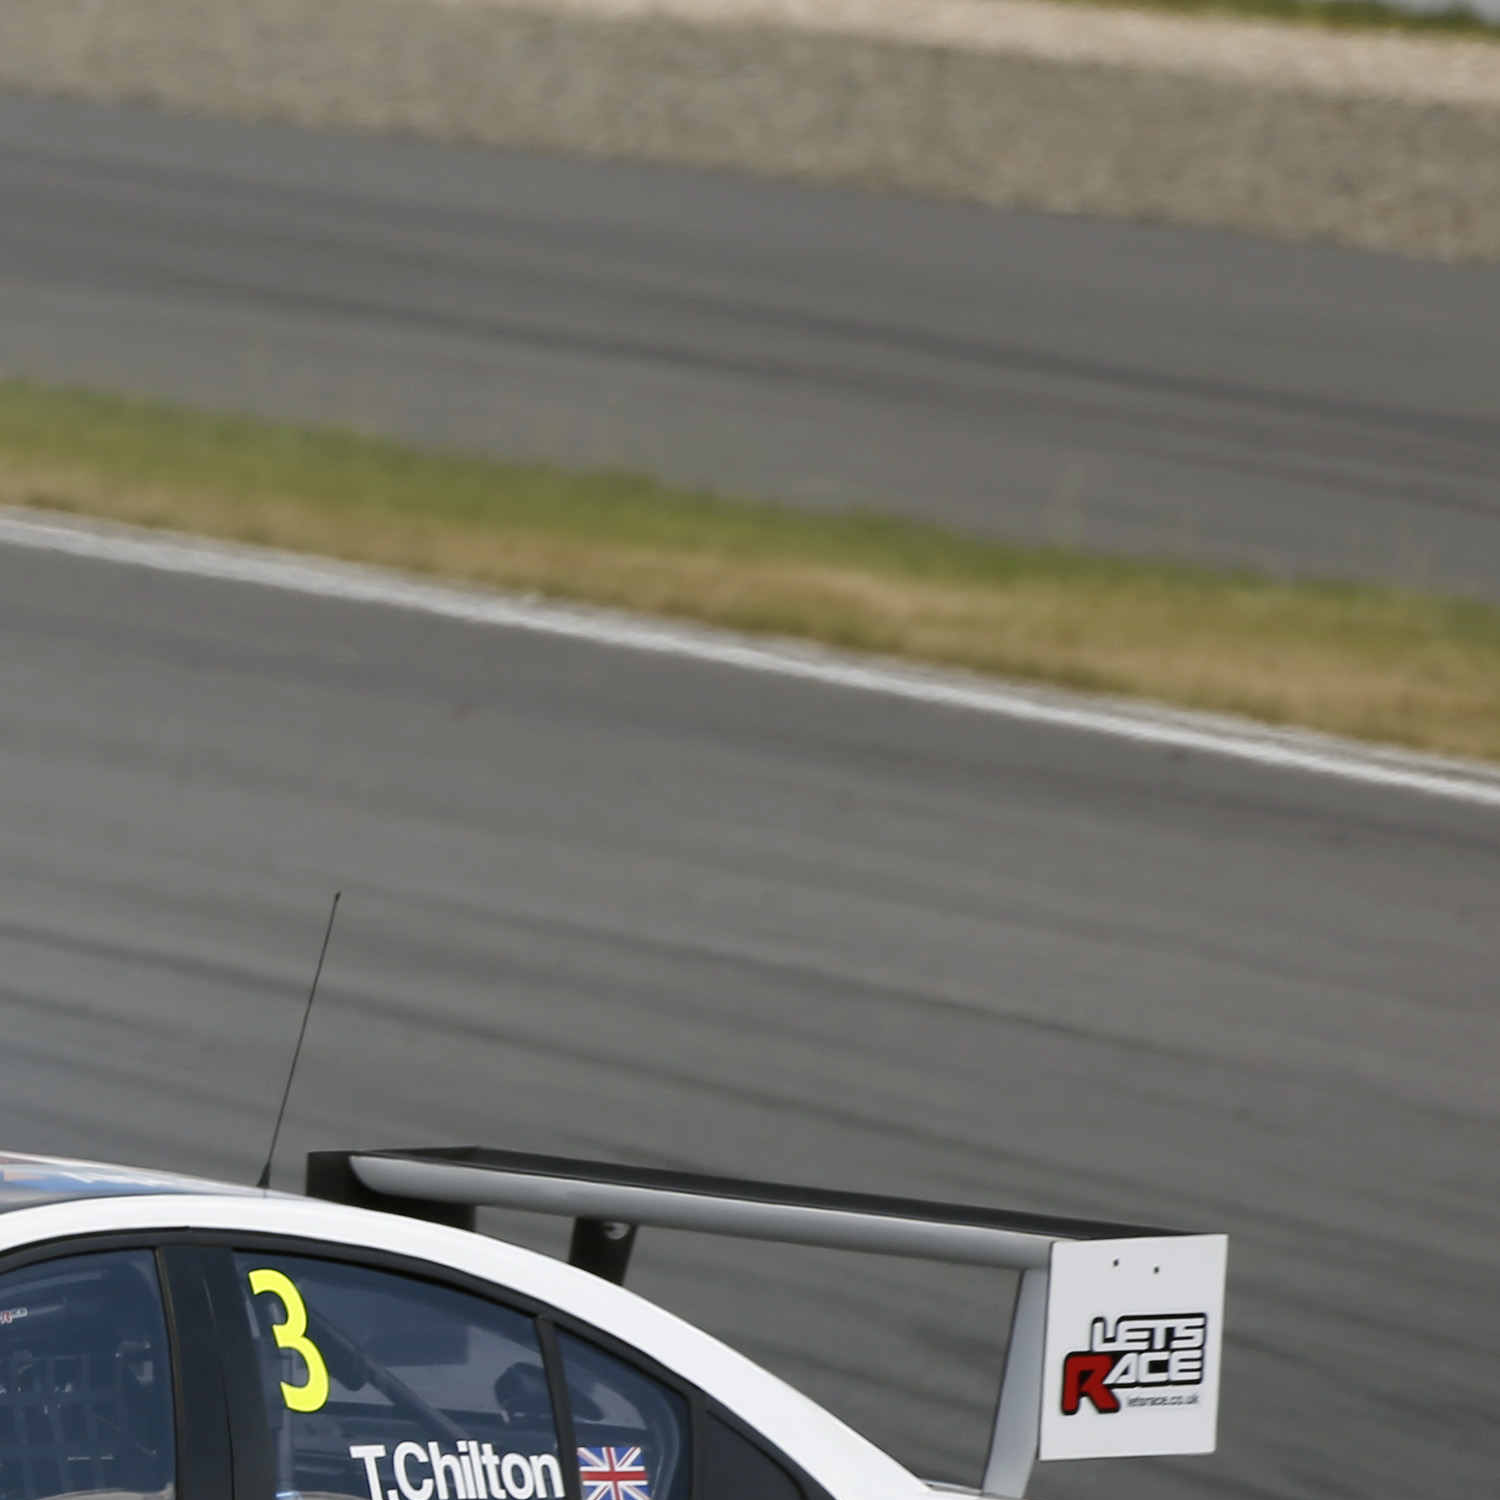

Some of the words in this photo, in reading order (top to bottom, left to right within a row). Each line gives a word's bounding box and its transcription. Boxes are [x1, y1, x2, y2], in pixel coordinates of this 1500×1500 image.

[249, 1268, 332, 1413] 3
[1090, 1312, 1207, 1352] LETS
[1060, 1352, 1204, 1416] RACE
